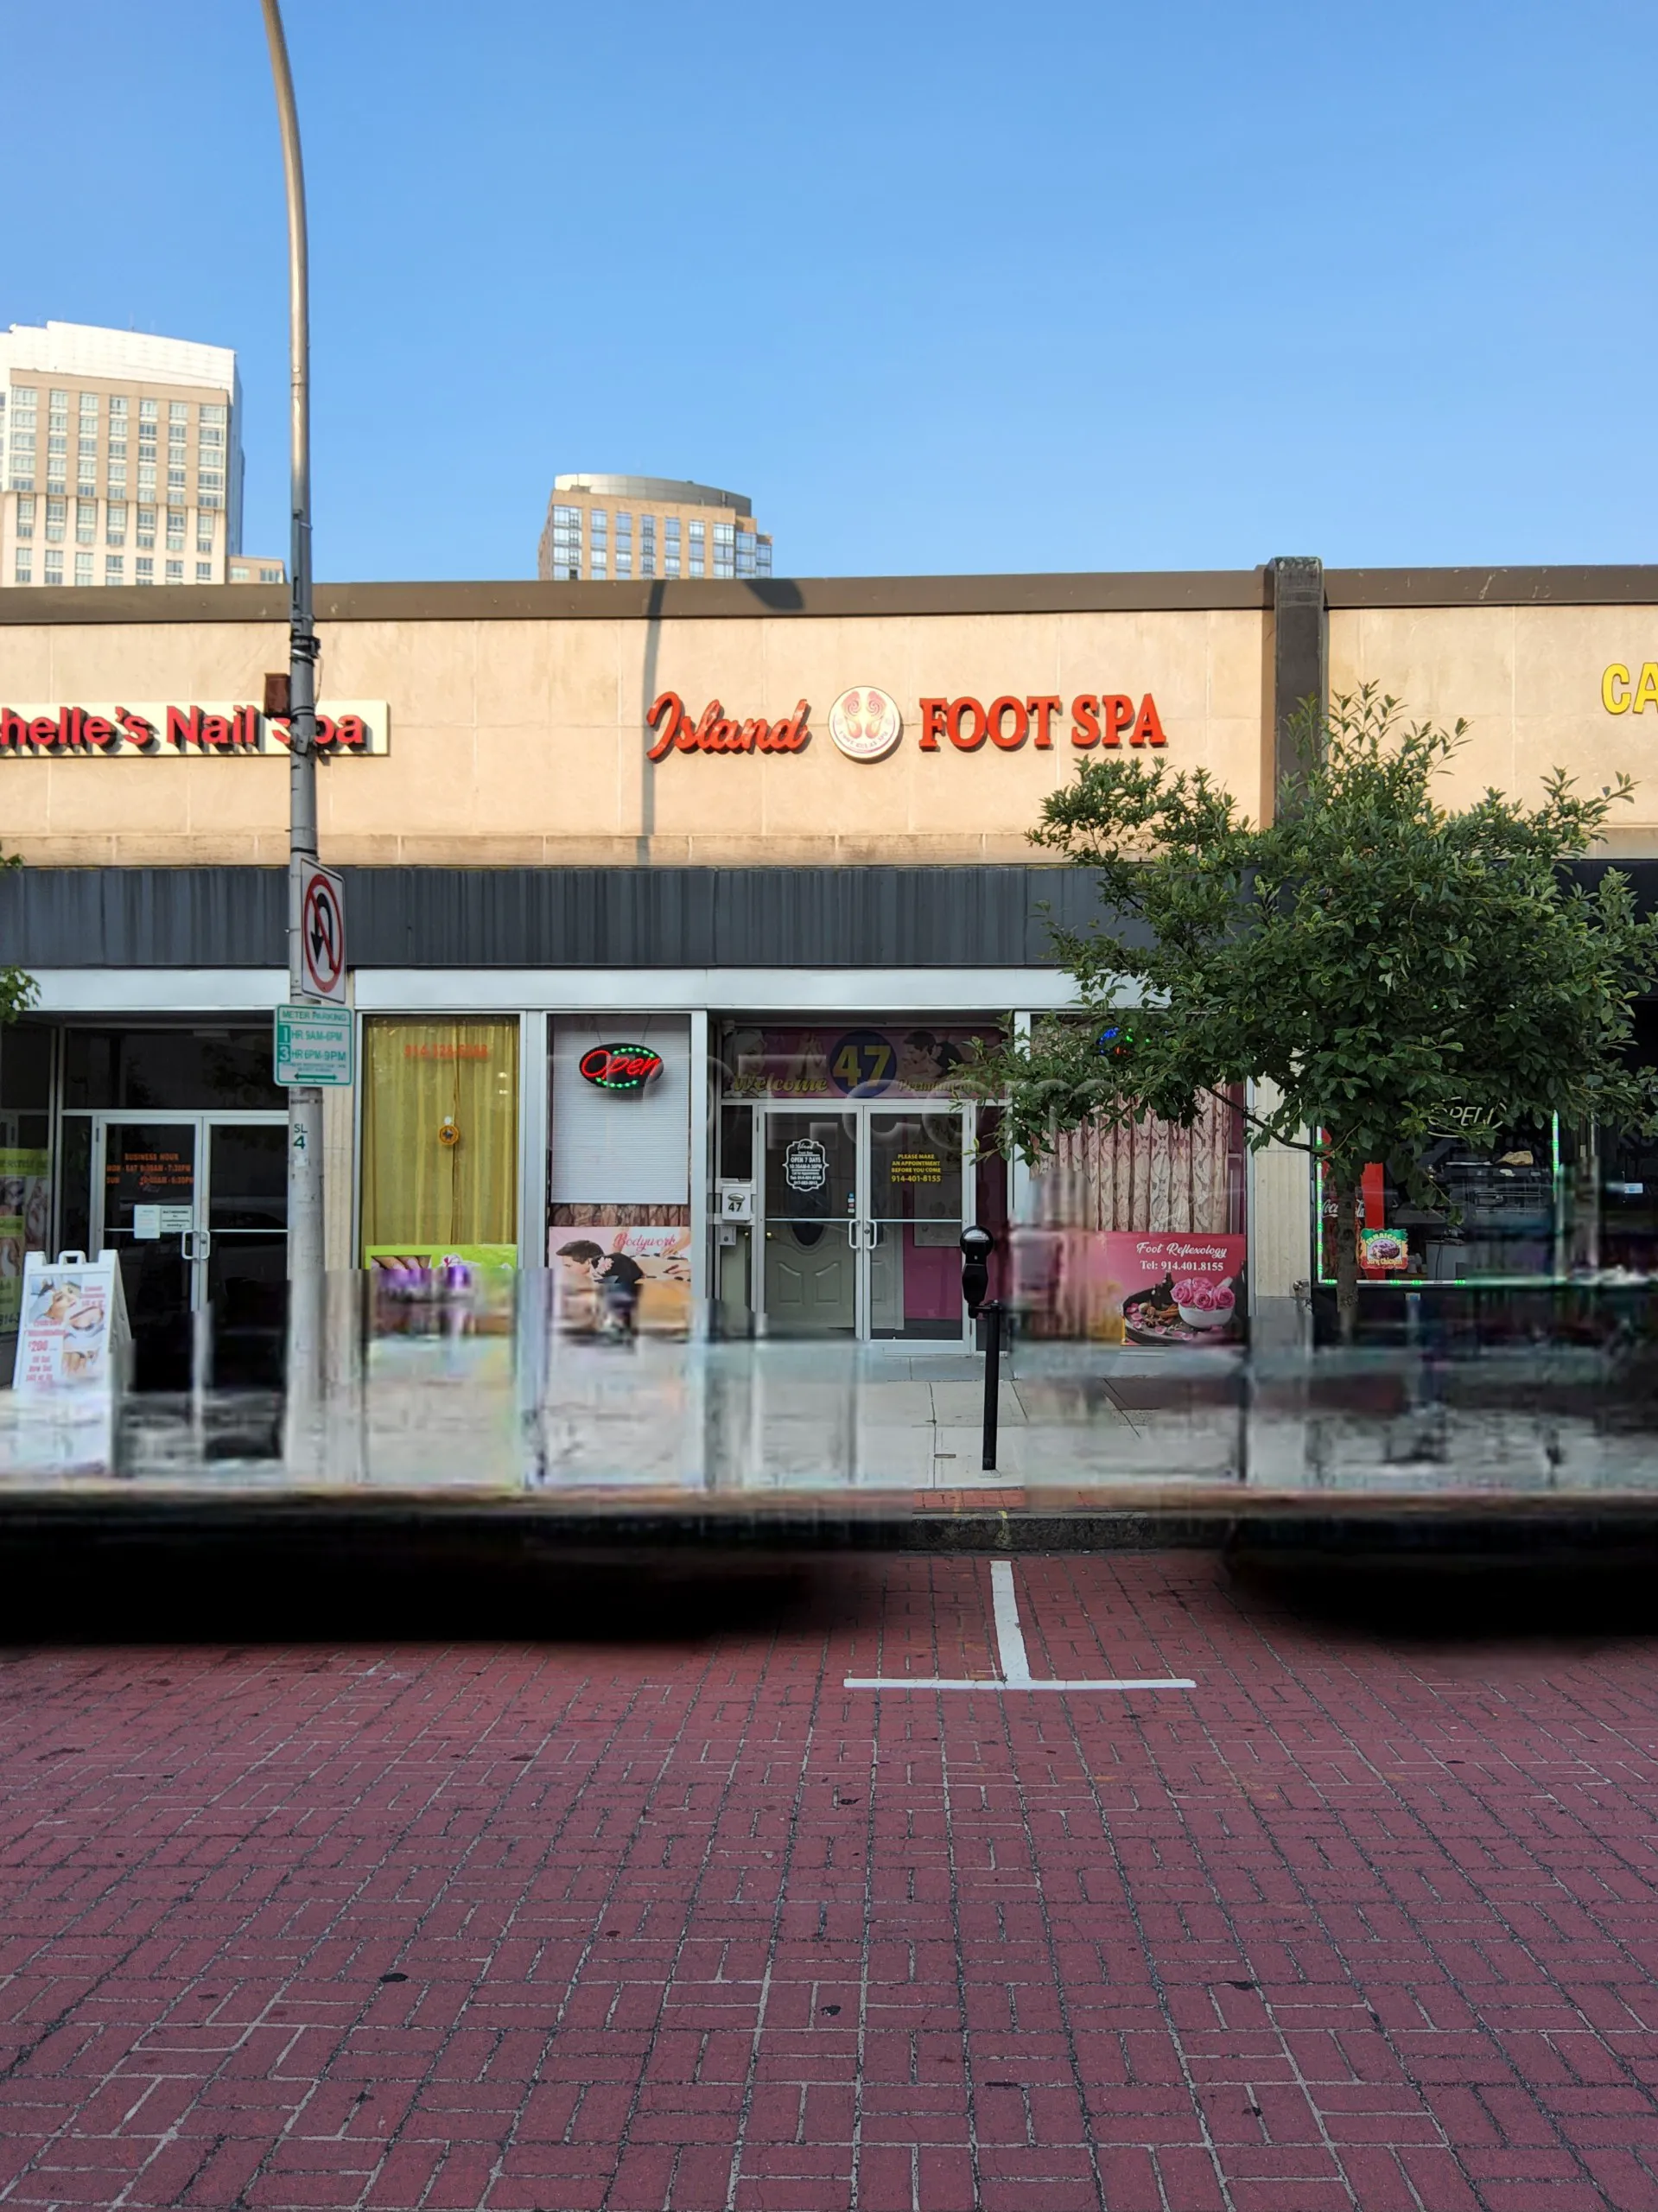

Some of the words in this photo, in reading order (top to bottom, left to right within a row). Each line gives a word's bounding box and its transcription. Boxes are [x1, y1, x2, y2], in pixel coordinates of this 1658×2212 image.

[0, 706, 151, 747] helle's
[167, 705, 257, 746] Nail
[646, 691, 810, 760] Island
[919, 696, 1062, 750] FOOT
[1071, 693, 1167, 747] SPA
[283, 1010, 309, 1019] METER
[313, 1011, 346, 1021] PARKING
[283, 1027, 289, 1042] 1
[292, 1029, 303, 1039] HR
[279, 1046, 289, 1061] 3
[581, 1050, 660, 1080] Open
[832, 1045, 891, 1087] 47
[732, 1071, 828, 1093] Welcome
[294, 1123, 308, 1133] SL
[293, 1135, 305, 1150] 4
[891, 1174, 942, 1183] 914-401-8155
[727, 1201, 743, 1212] 47
[613, 1231, 677, 1255] Bodywork
[1136, 1242, 1164, 1254] Foot
[1166, 1242, 1228, 1258] Reflexology
[1140, 1260, 1158, 1269] Tel:
[1160, 1261, 1223, 1271] 914.401.8155
